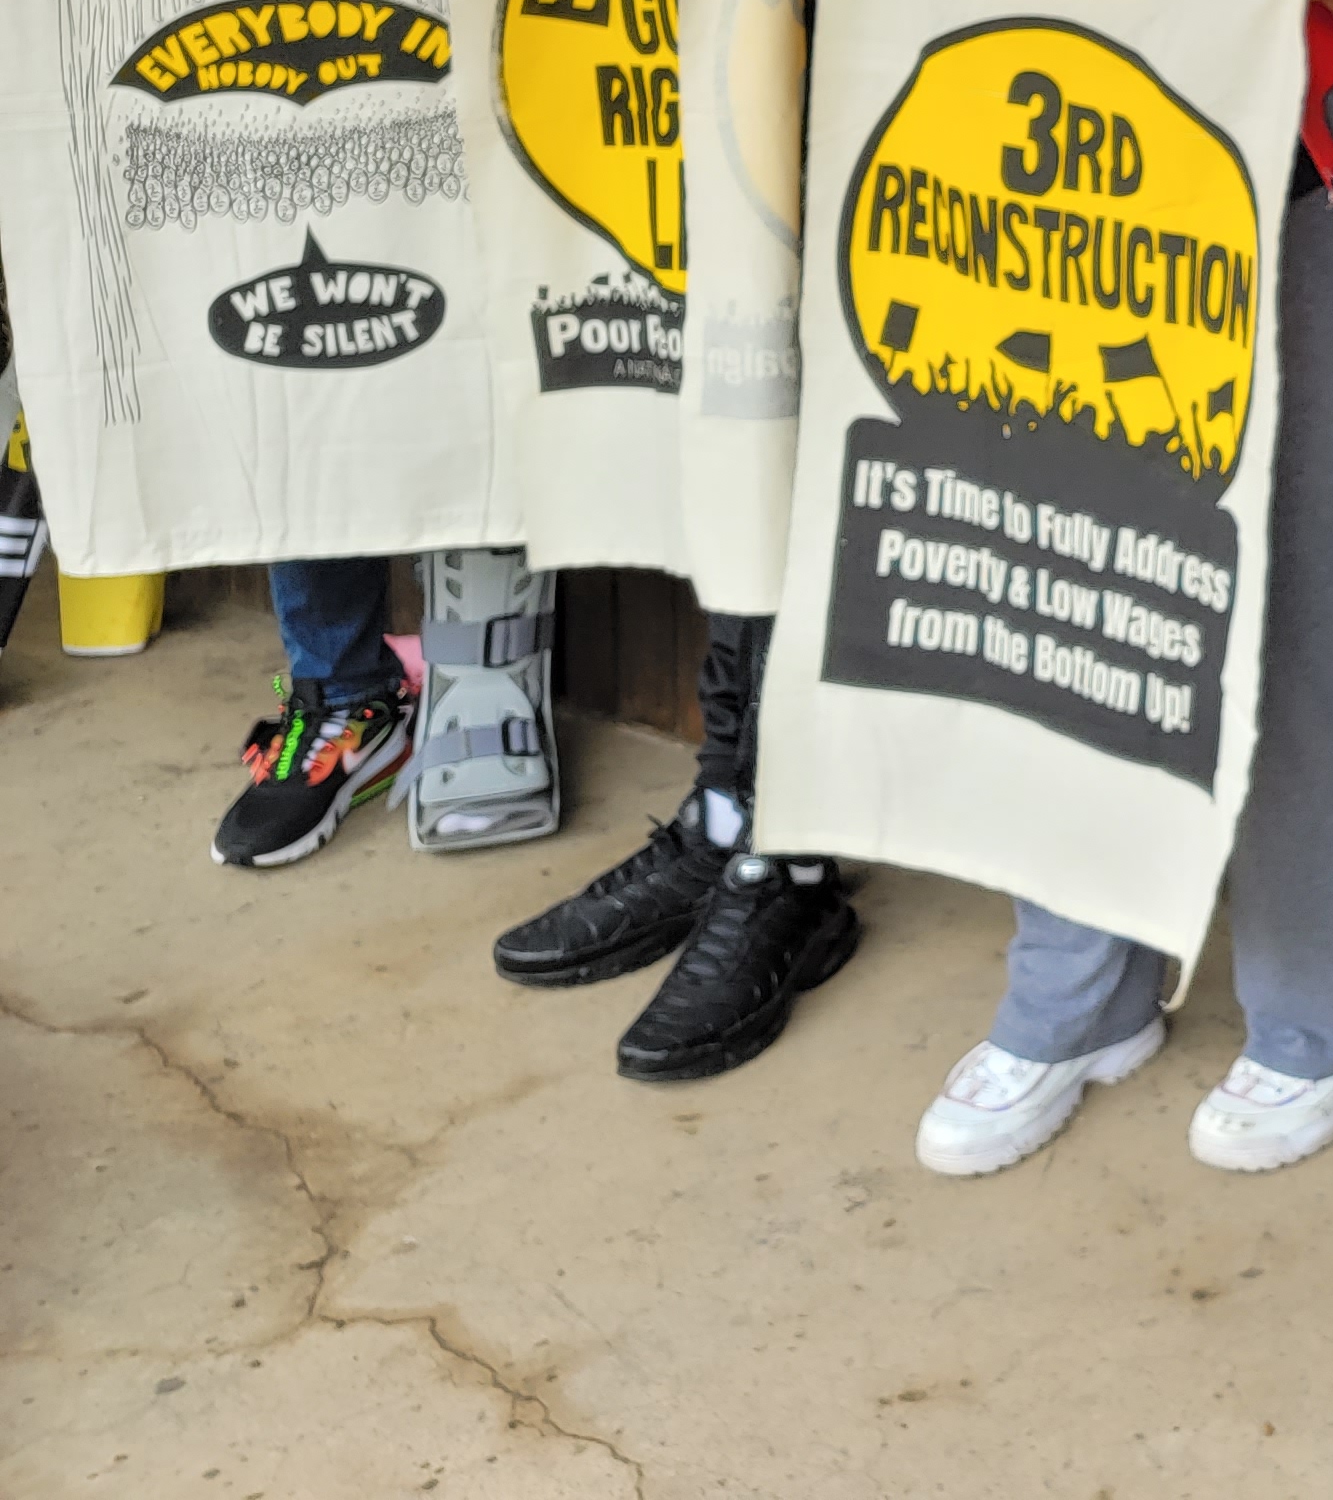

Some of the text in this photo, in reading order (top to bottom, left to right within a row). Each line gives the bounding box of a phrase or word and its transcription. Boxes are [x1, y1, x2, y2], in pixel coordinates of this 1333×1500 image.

[135, 0, 452, 93] EVERYBODY IN
[197, 53, 382, 95] NOBODY OUT
[596, 65, 679, 146] RIG
[1001, 71, 1143, 197] 3RD
[230, 270, 435, 322] WE WON'T
[867, 163, 1253, 350] RECONSTRUCTION
[244, 309, 420, 358] BE SILENT
[547, 313, 682, 362] Poor Peo
[855, 459, 1232, 614] It's Time to Fully Address
[876, 528, 1202, 667] Poverty & Low Wages
[887, 598, 1194, 734] from the Bottom Up!
